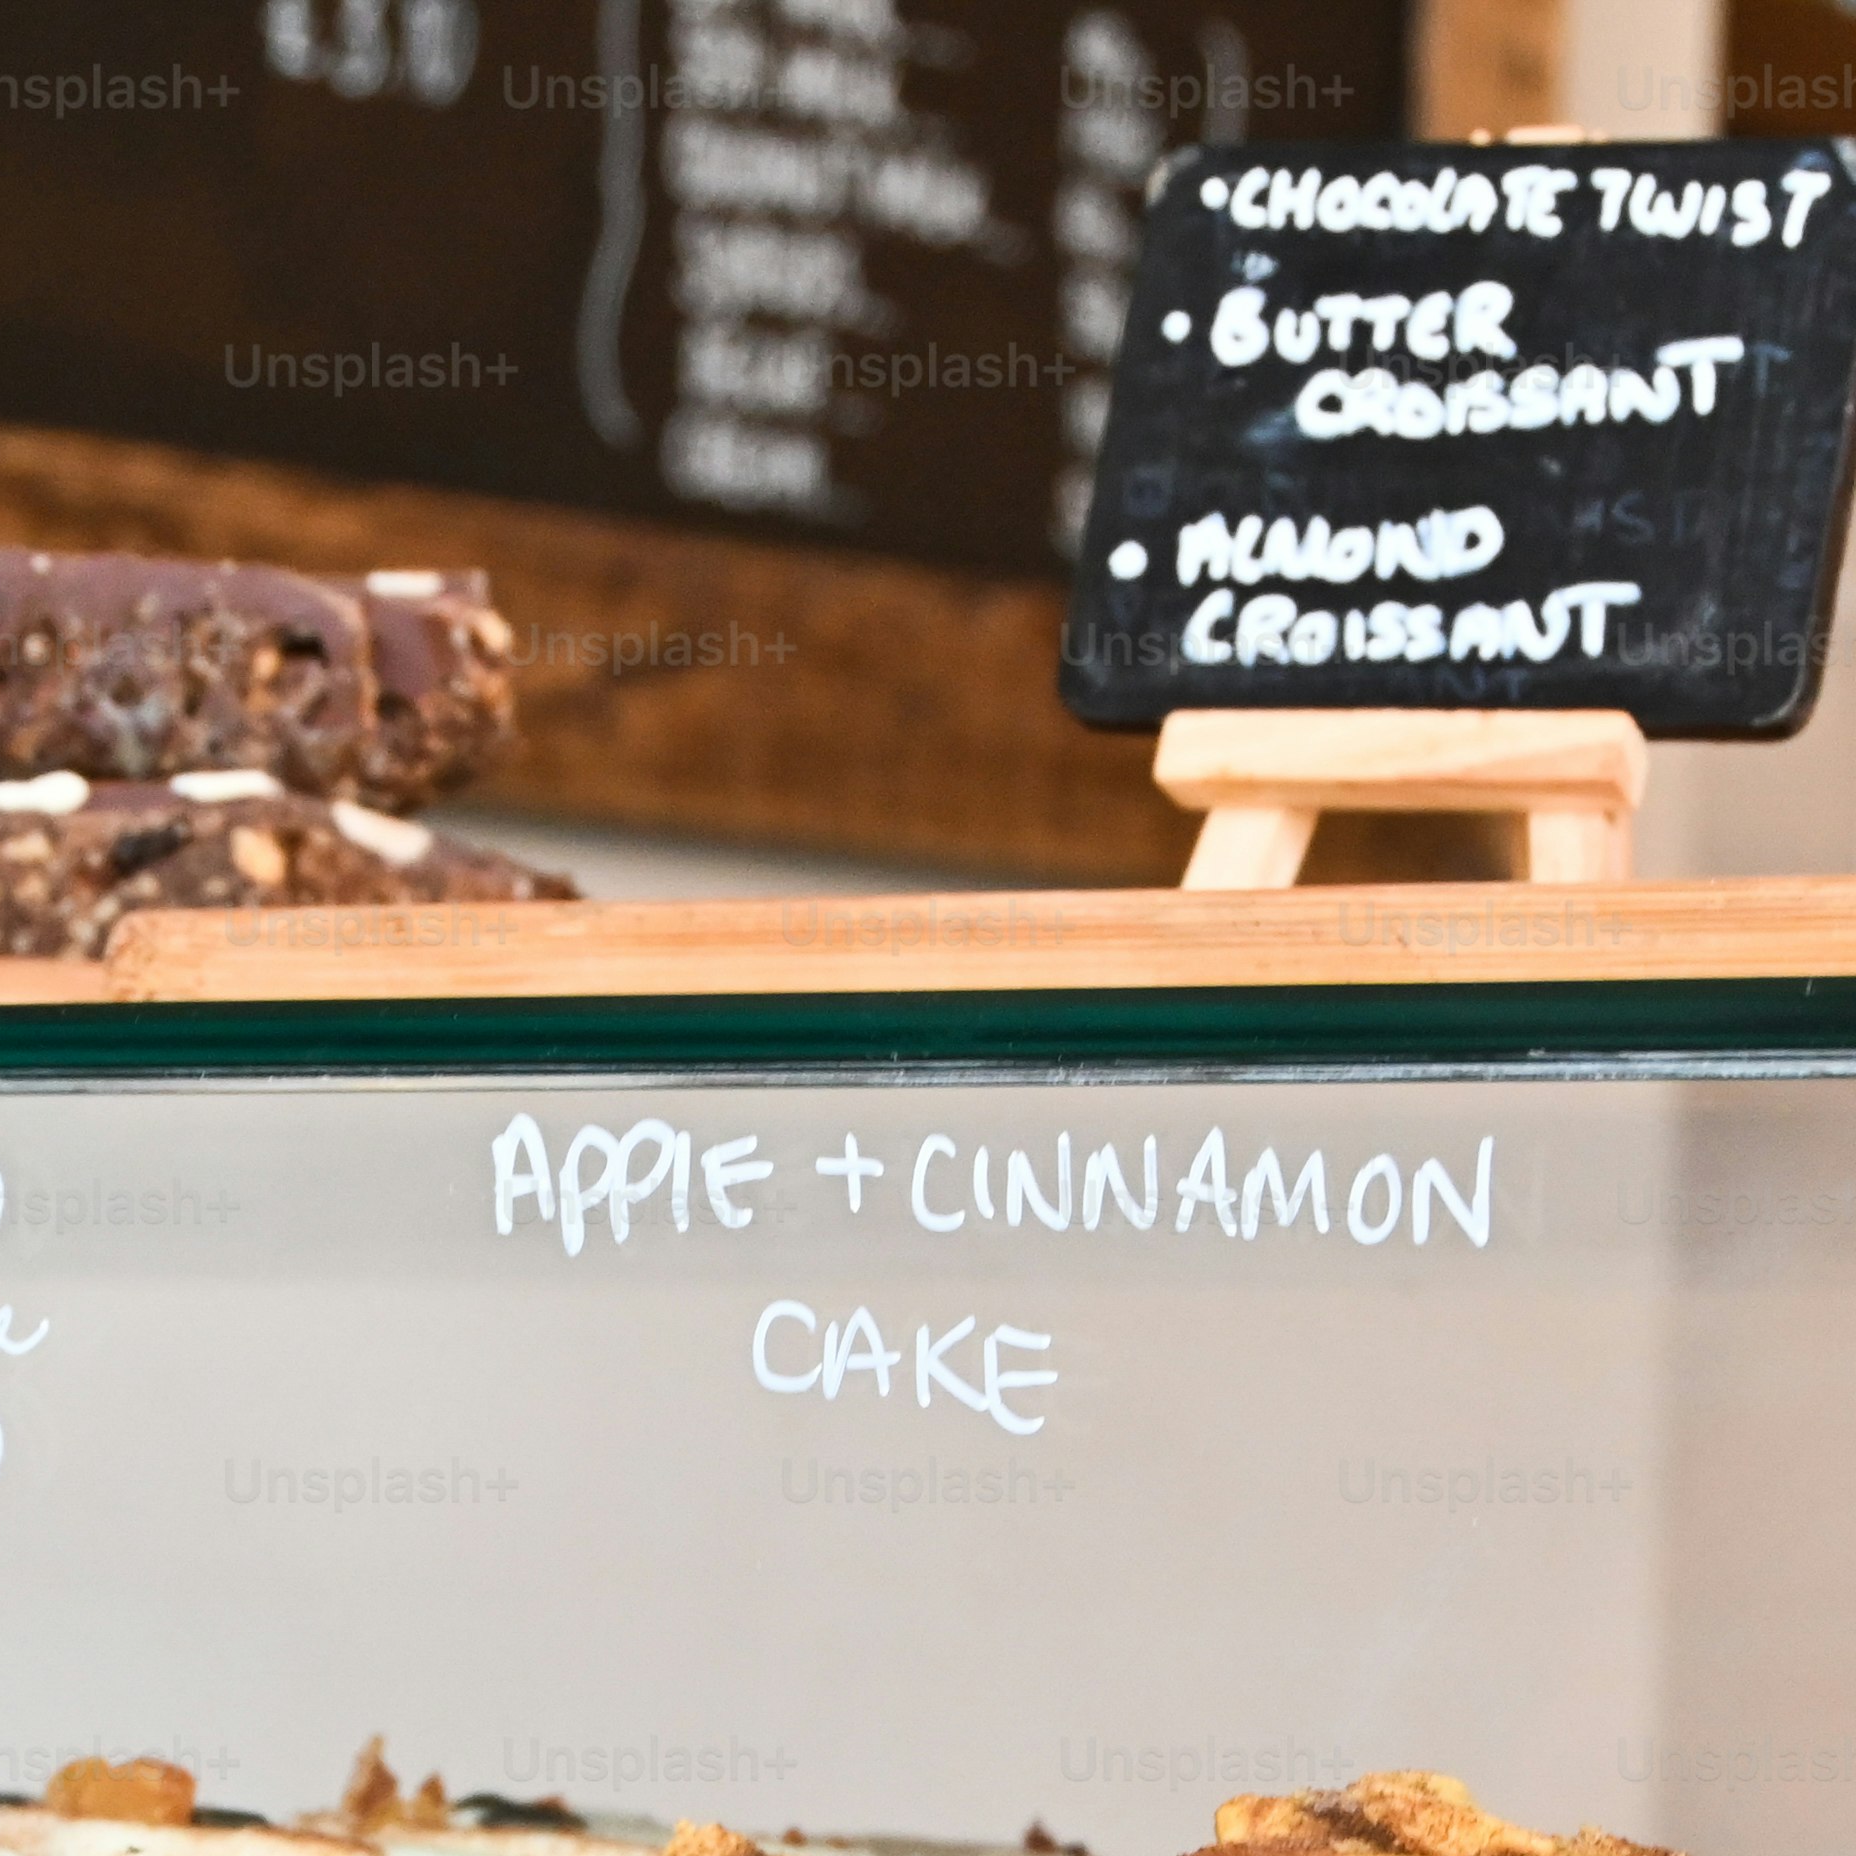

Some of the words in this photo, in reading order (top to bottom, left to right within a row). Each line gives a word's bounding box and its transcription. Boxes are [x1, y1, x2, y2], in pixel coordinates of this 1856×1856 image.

[1230, 166, 1579, 238] CHOCOLATE
[1592, 168, 1831, 247] TWIST
[1210, 281, 1518, 366] BUTTER
[1296, 337, 1743, 442] CROISSANT
[1178, 505, 1504, 586] ALMOND
[1182, 581, 1642, 668] CROISSANT
[911, 1126, 1494, 1250] CINNAMON
[753, 1299, 1058, 1435] CAKE
